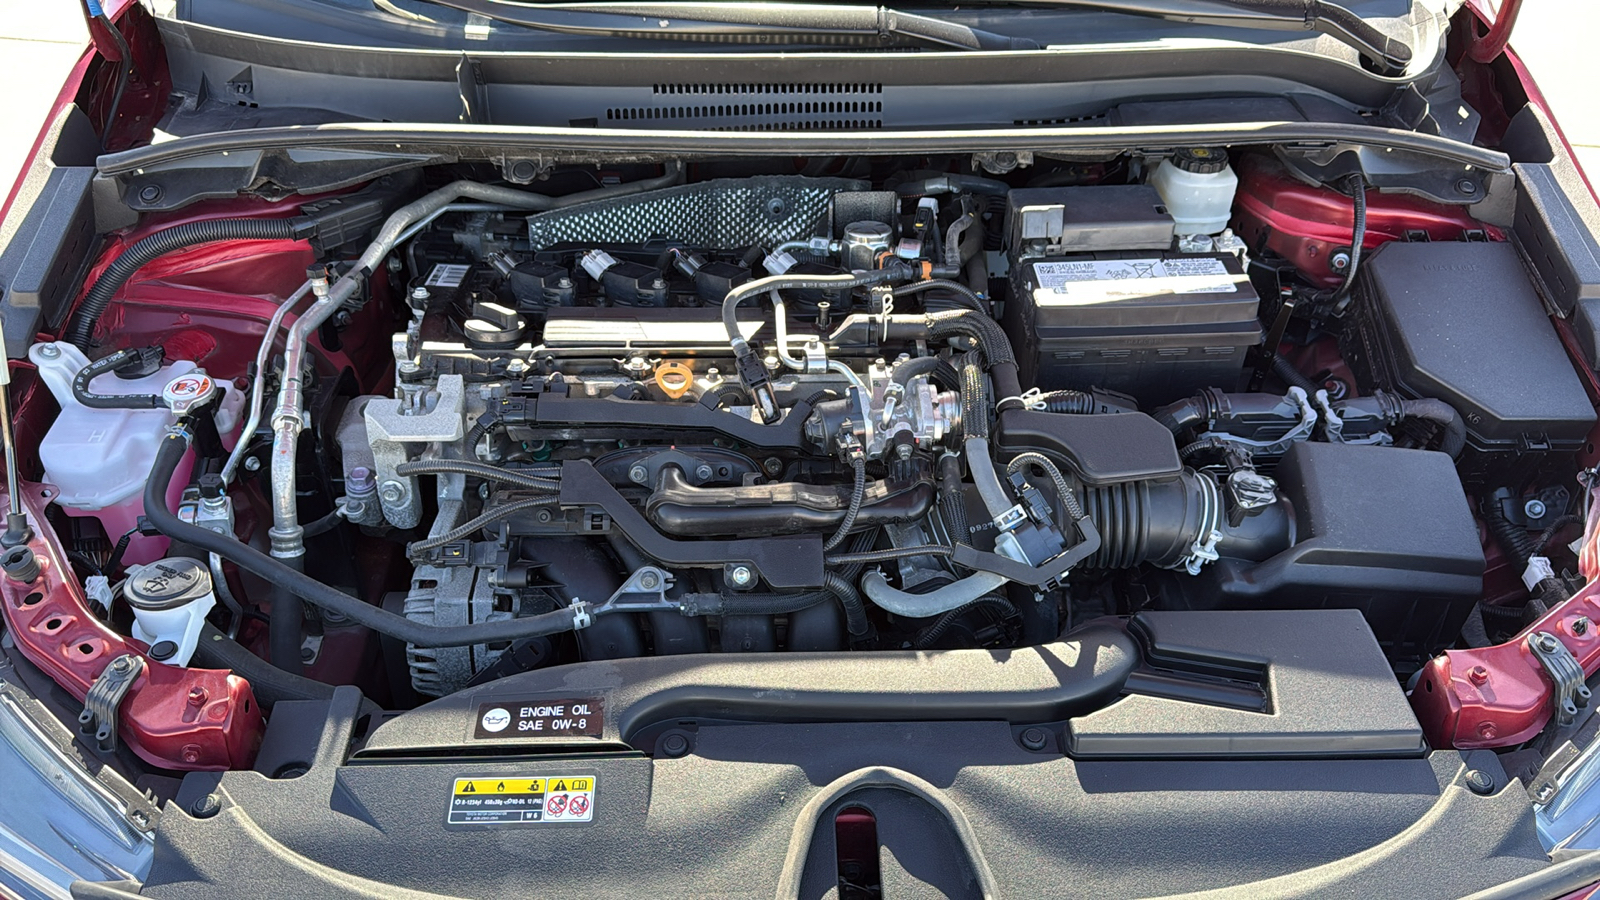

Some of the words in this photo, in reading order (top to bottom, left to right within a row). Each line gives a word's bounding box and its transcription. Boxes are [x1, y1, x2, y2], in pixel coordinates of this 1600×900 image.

[1466, 411, 1482, 425] K6
[87, 429, 106, 442] H
[520, 706, 564, 718] ENGINE
[572, 704, 592, 716] OIL
[518, 719, 543, 731] SAE
[552, 718, 587, 730] 0W-8
